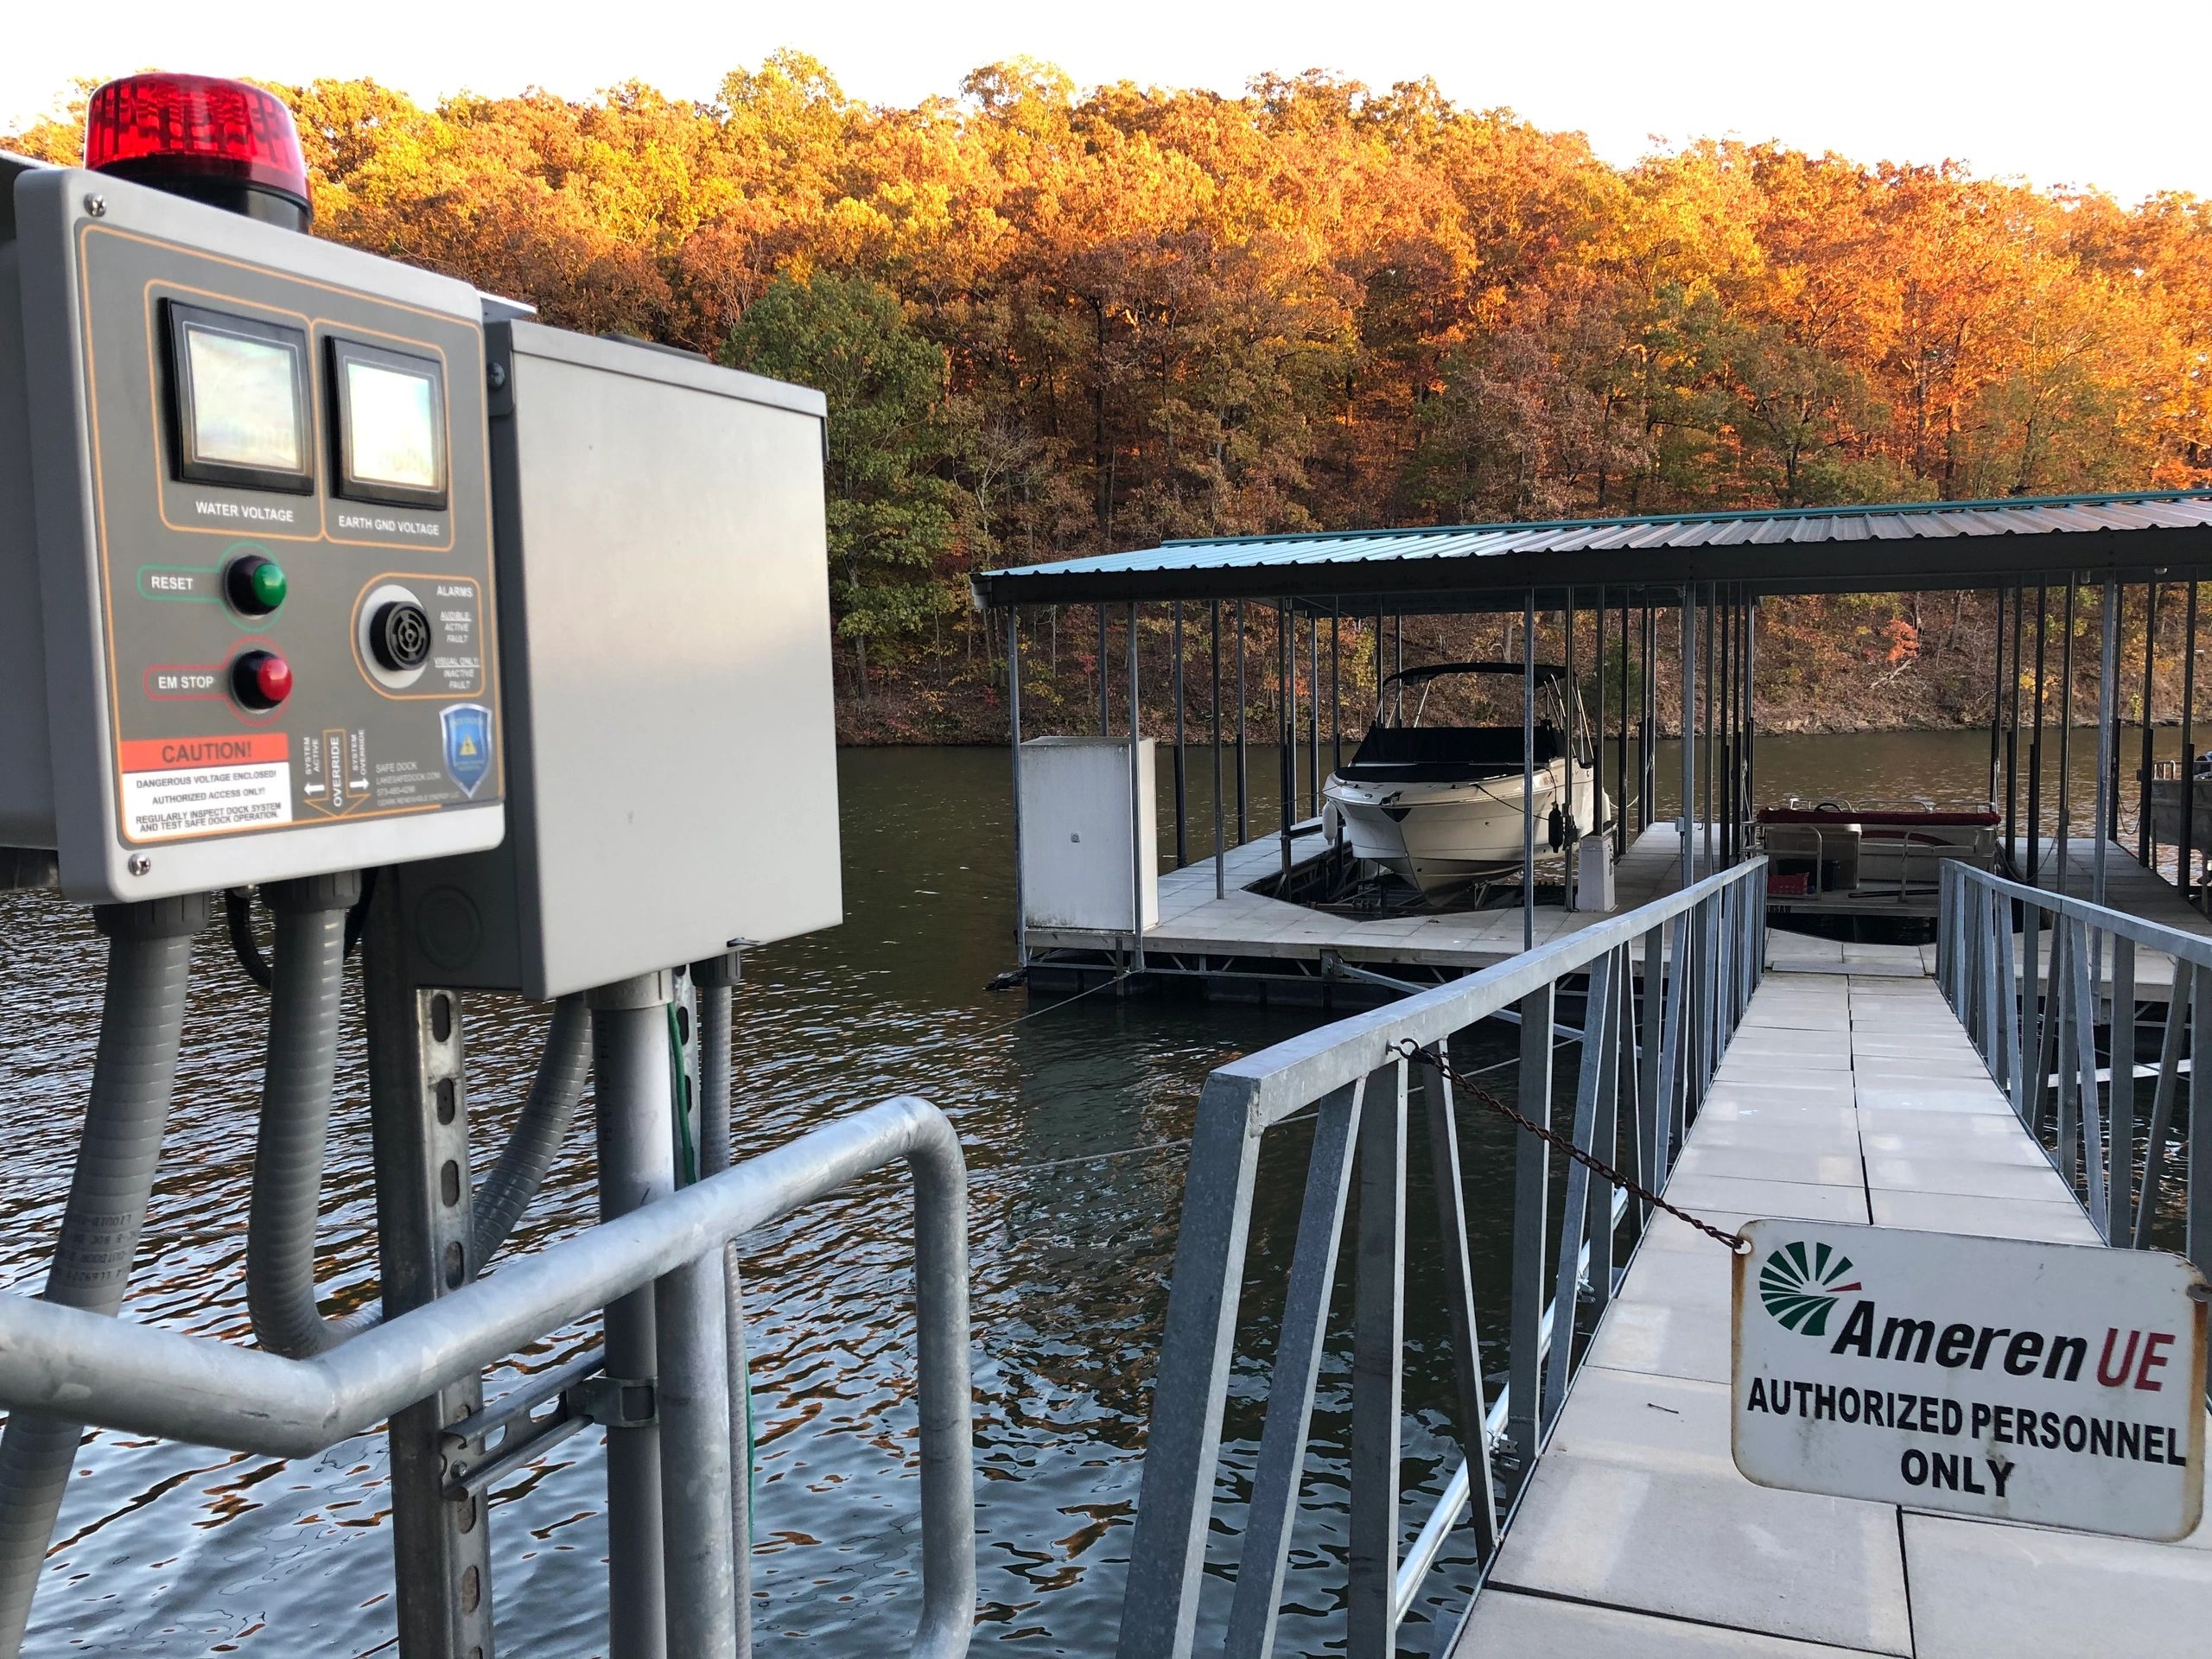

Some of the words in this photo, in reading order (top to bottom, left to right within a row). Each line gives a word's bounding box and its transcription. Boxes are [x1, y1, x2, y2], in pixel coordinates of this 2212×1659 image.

[195, 501, 238, 518] WATER
[240, 505, 294, 523] VOLTAGE
[338, 515, 372, 531] EARTH
[374, 518, 396, 532] GND
[397, 519, 440, 537] VOLTAGE
[150, 575, 194, 591] RESET
[436, 585, 474, 598] ALARMS
[444, 623, 469, 632] ACTIVE
[158, 676, 177, 690] EM
[181, 676, 215, 690] STOP
[162, 741, 252, 764] CAUTION!
[351, 734, 359, 771] SYSTEM
[359, 728, 367, 776] OVERRIDE
[330, 736, 342, 808] OVERRIDE
[375, 762, 395, 774] SAFE
[396, 761, 418, 772] DOCK
[136, 774, 192, 789] DANGEROUS
[193, 772, 231, 785] VOLTAGE
[232, 770, 276, 781] ENCLOSED!
[152, 792, 207, 805] AUTHORIZED
[208, 789, 241, 800] ACCESS
[243, 787, 265, 798] ONLY!
[136, 811, 188, 825] REGULARLY
[189, 807, 225, 819] INSPECT
[226, 804, 249, 816] DOCK
[251, 802, 282, 813] SYSTEM
[140, 823, 159, 833] AND
[161, 820, 183, 831] TEST
[184, 817, 207, 829] SAFE
[208, 815, 232, 826] DOCK
[1746, 1377, 1962, 1436] AUTHORIZED
[1972, 1402, 2188, 1467] PERSONNEL
[1900, 1448, 2016, 1498] ONLY
